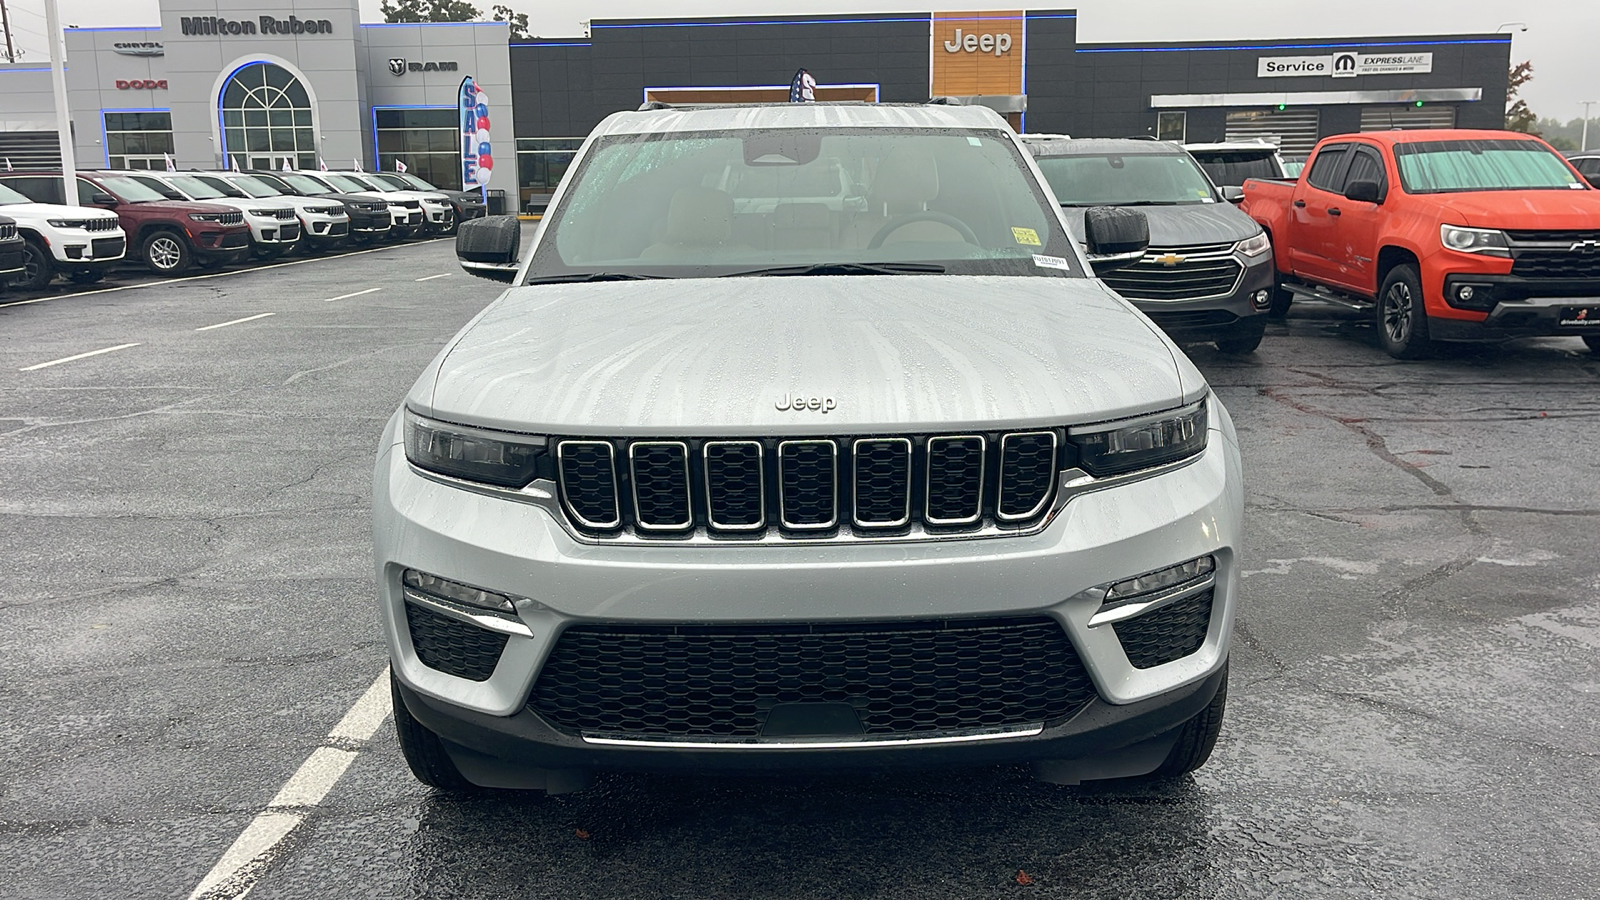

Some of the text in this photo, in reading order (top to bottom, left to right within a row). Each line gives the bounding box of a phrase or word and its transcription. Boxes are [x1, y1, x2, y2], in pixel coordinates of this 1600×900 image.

[180, 15, 333, 36] Milton Ruben
[944, 28, 1012, 57] Jeep
[408, 61, 458, 72] RAM
[1266, 60, 1325, 72] Service
[115, 79, 168, 90] DODG
[463, 84, 478, 185] SALE
[775, 393, 837, 414] Jeep
